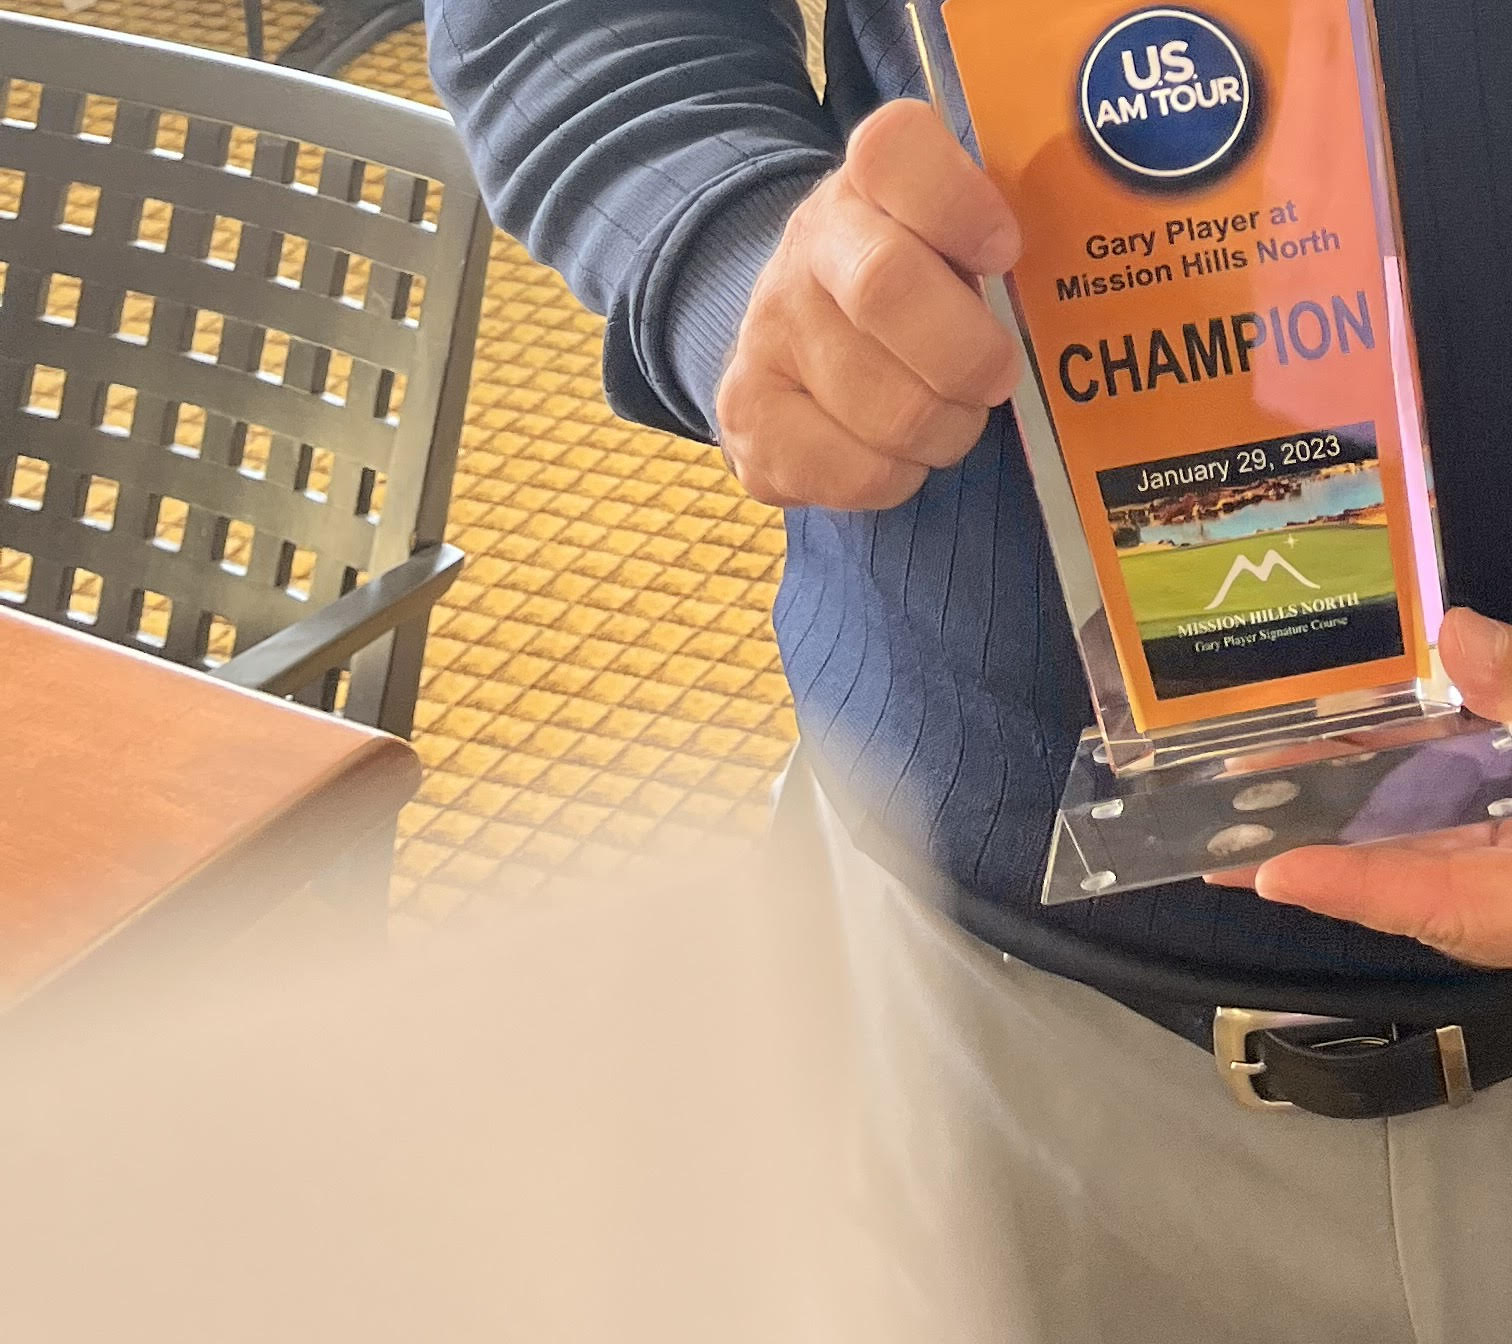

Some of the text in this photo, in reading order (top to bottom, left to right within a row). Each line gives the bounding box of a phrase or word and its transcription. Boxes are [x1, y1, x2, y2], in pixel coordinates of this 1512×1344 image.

[1096, 76, 1242, 129] AM TOUR
[1085, 199, 1298, 260] Gary Player at
[1055, 227, 1341, 302] Mission Hills North
[1057, 289, 1376, 406] CHAMPION
[1136, 434, 1341, 493] January 29, 2023
[1177, 591, 1360, 639] MISSION HILLS NORTH
[1194, 615, 1349, 654] Gary Player Signature Course
